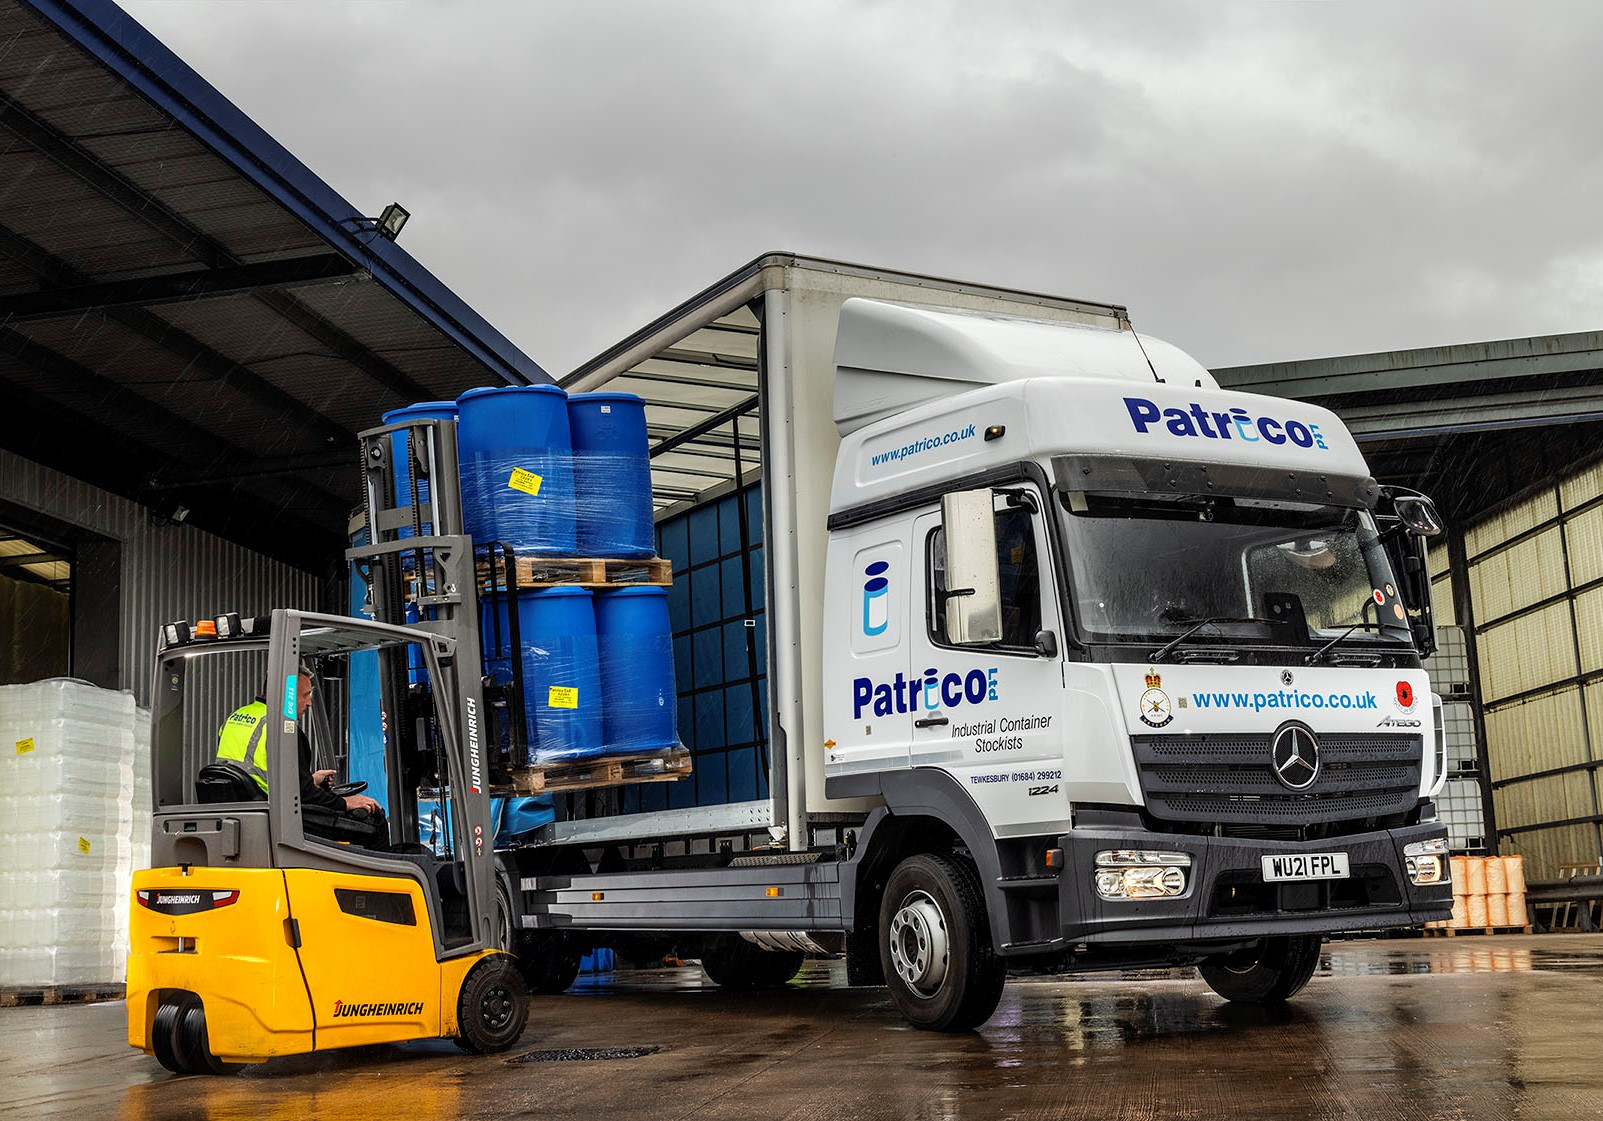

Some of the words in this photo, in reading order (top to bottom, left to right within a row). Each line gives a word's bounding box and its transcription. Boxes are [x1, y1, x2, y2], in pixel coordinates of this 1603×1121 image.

[1123, 397, 1314, 449] Patrico
[1308, 423, 1329, 450] Ltd
[871, 424, 976, 466] www.patrico.co.uk
[853, 668, 987, 719] Patrico
[988, 668, 998, 701] Ltd
[1193, 689, 1378, 712] www.patrico.co.uk
[951, 720, 996, 738] Industrial
[999, 714, 1052, 733] Container
[467, 697, 482, 794] JUNGHEINRICH
[975, 736, 1023, 753] Stockists
[970, 774, 1010, 784] TEWKESBURY
[1011, 771, 1036, 782] (01684)
[1037, 770, 1062, 780] 299212
[1028, 784, 1059, 797] 1224
[1272, 857, 1308, 877] WU21
[1311, 855, 1341, 875] FPL
[333, 1000, 424, 1018] JUNGHEINRICH
